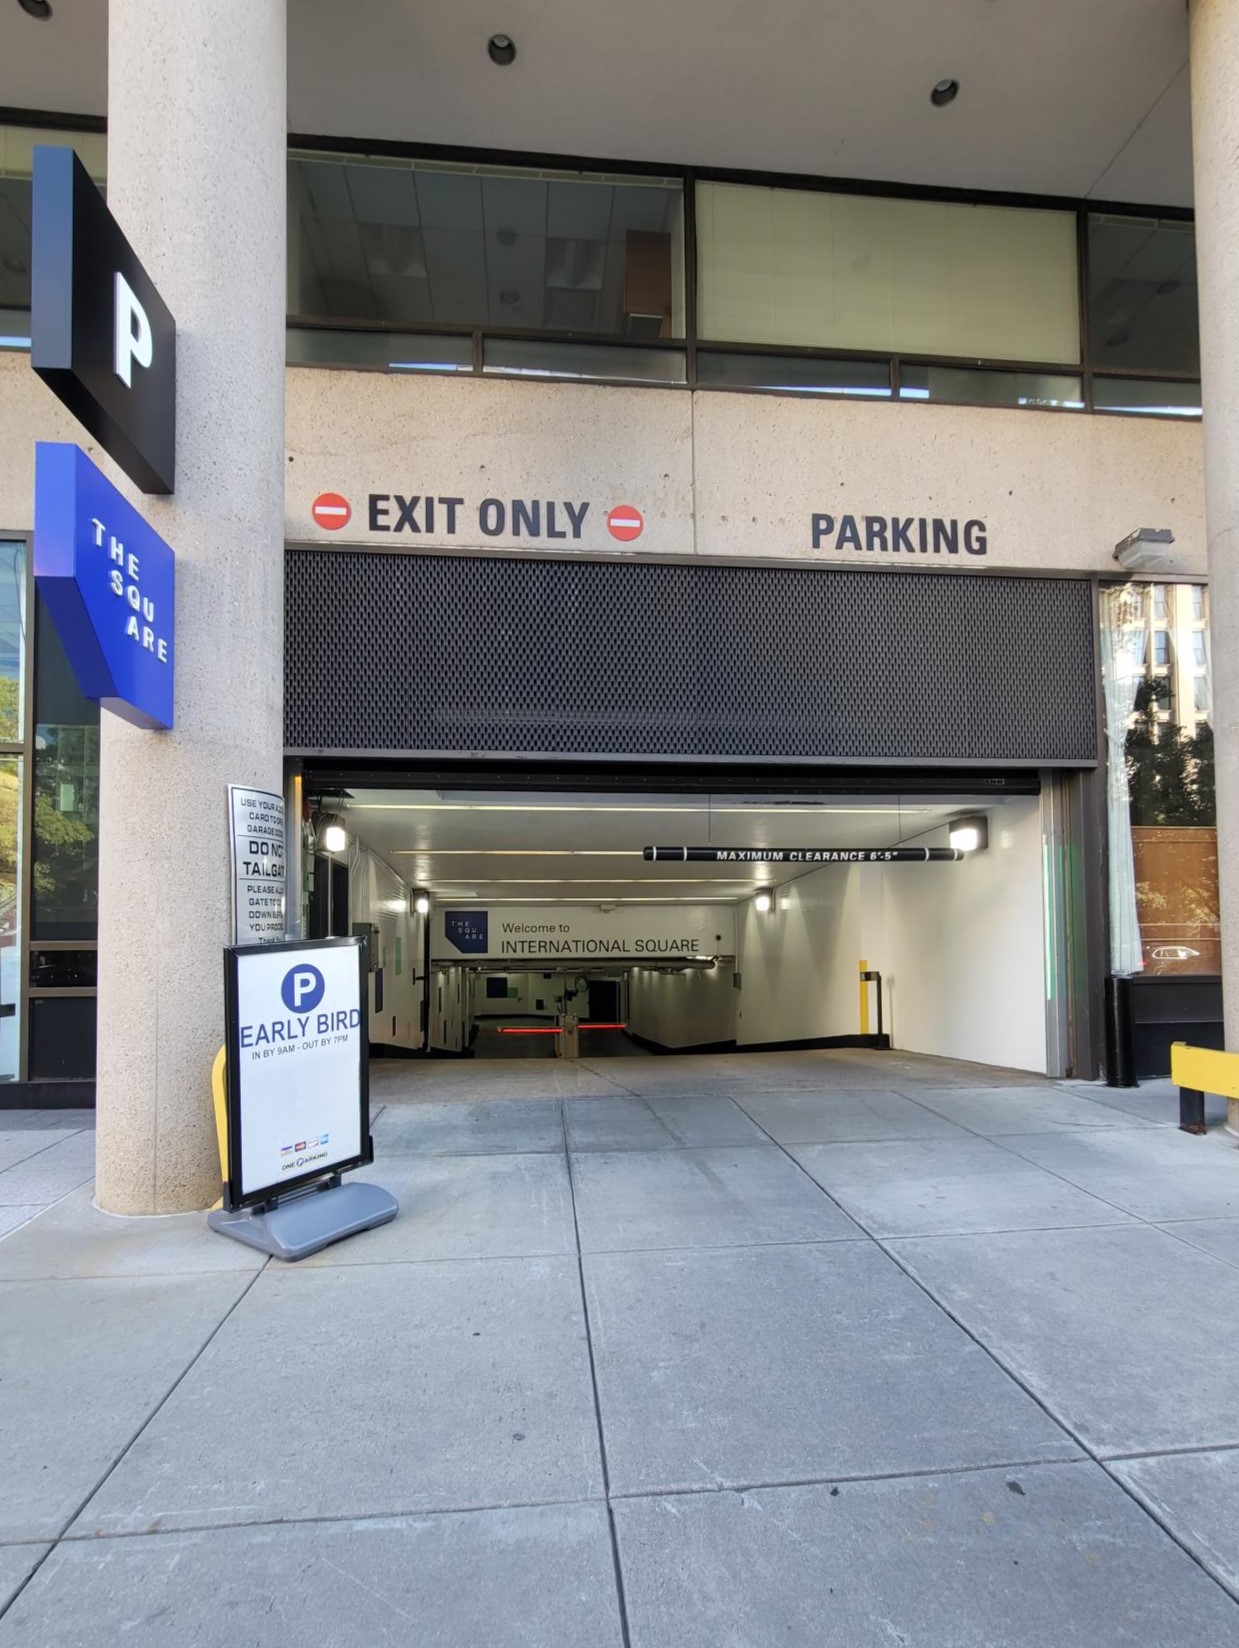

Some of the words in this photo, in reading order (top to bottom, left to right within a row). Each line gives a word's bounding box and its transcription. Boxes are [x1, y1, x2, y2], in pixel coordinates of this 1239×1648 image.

[113, 271, 153, 389] P
[368, 493, 464, 535] EXIT
[479, 498, 590, 539] ONLY
[811, 513, 987, 555] PARKING
[90, 518, 140, 582] THE
[109, 569, 154, 622] SQU
[126, 615, 168, 663] ARE
[240, 798, 257, 808] USE
[258, 801, 275, 811] YOUR
[249, 812, 270, 822] CARD
[247, 824, 275, 836] GARAGE
[249, 841, 269, 855] DO
[716, 850, 784, 862] MAXIMUM
[789, 851, 866, 862] CLEARANCE
[243, 861, 285, 878] TAILGAT
[247, 885, 275, 894] PLEASE
[249, 898, 269, 906] GATE
[248, 911, 272, 919] DOWN
[249, 923, 267, 931] YOU
[501, 922, 556, 933] Welcome
[559, 923, 570, 933] to
[501, 939, 630, 954] INTERNATIONAL
[634, 938, 700, 953] SQUARE
[293, 971, 317, 1007] P
[240, 1016, 310, 1048] EARLY
[317, 1009, 361, 1035] BIRD
[252, 1051, 260, 1060] IN
[263, 1048, 275, 1058] BY
[277, 1044, 296, 1056] 9AM
[302, 1039, 319, 1050] OUT
[321, 1037, 332, 1046] BY
[334, 1034, 349, 1044] 7PM
[282, 1162, 295, 1171] ONE
